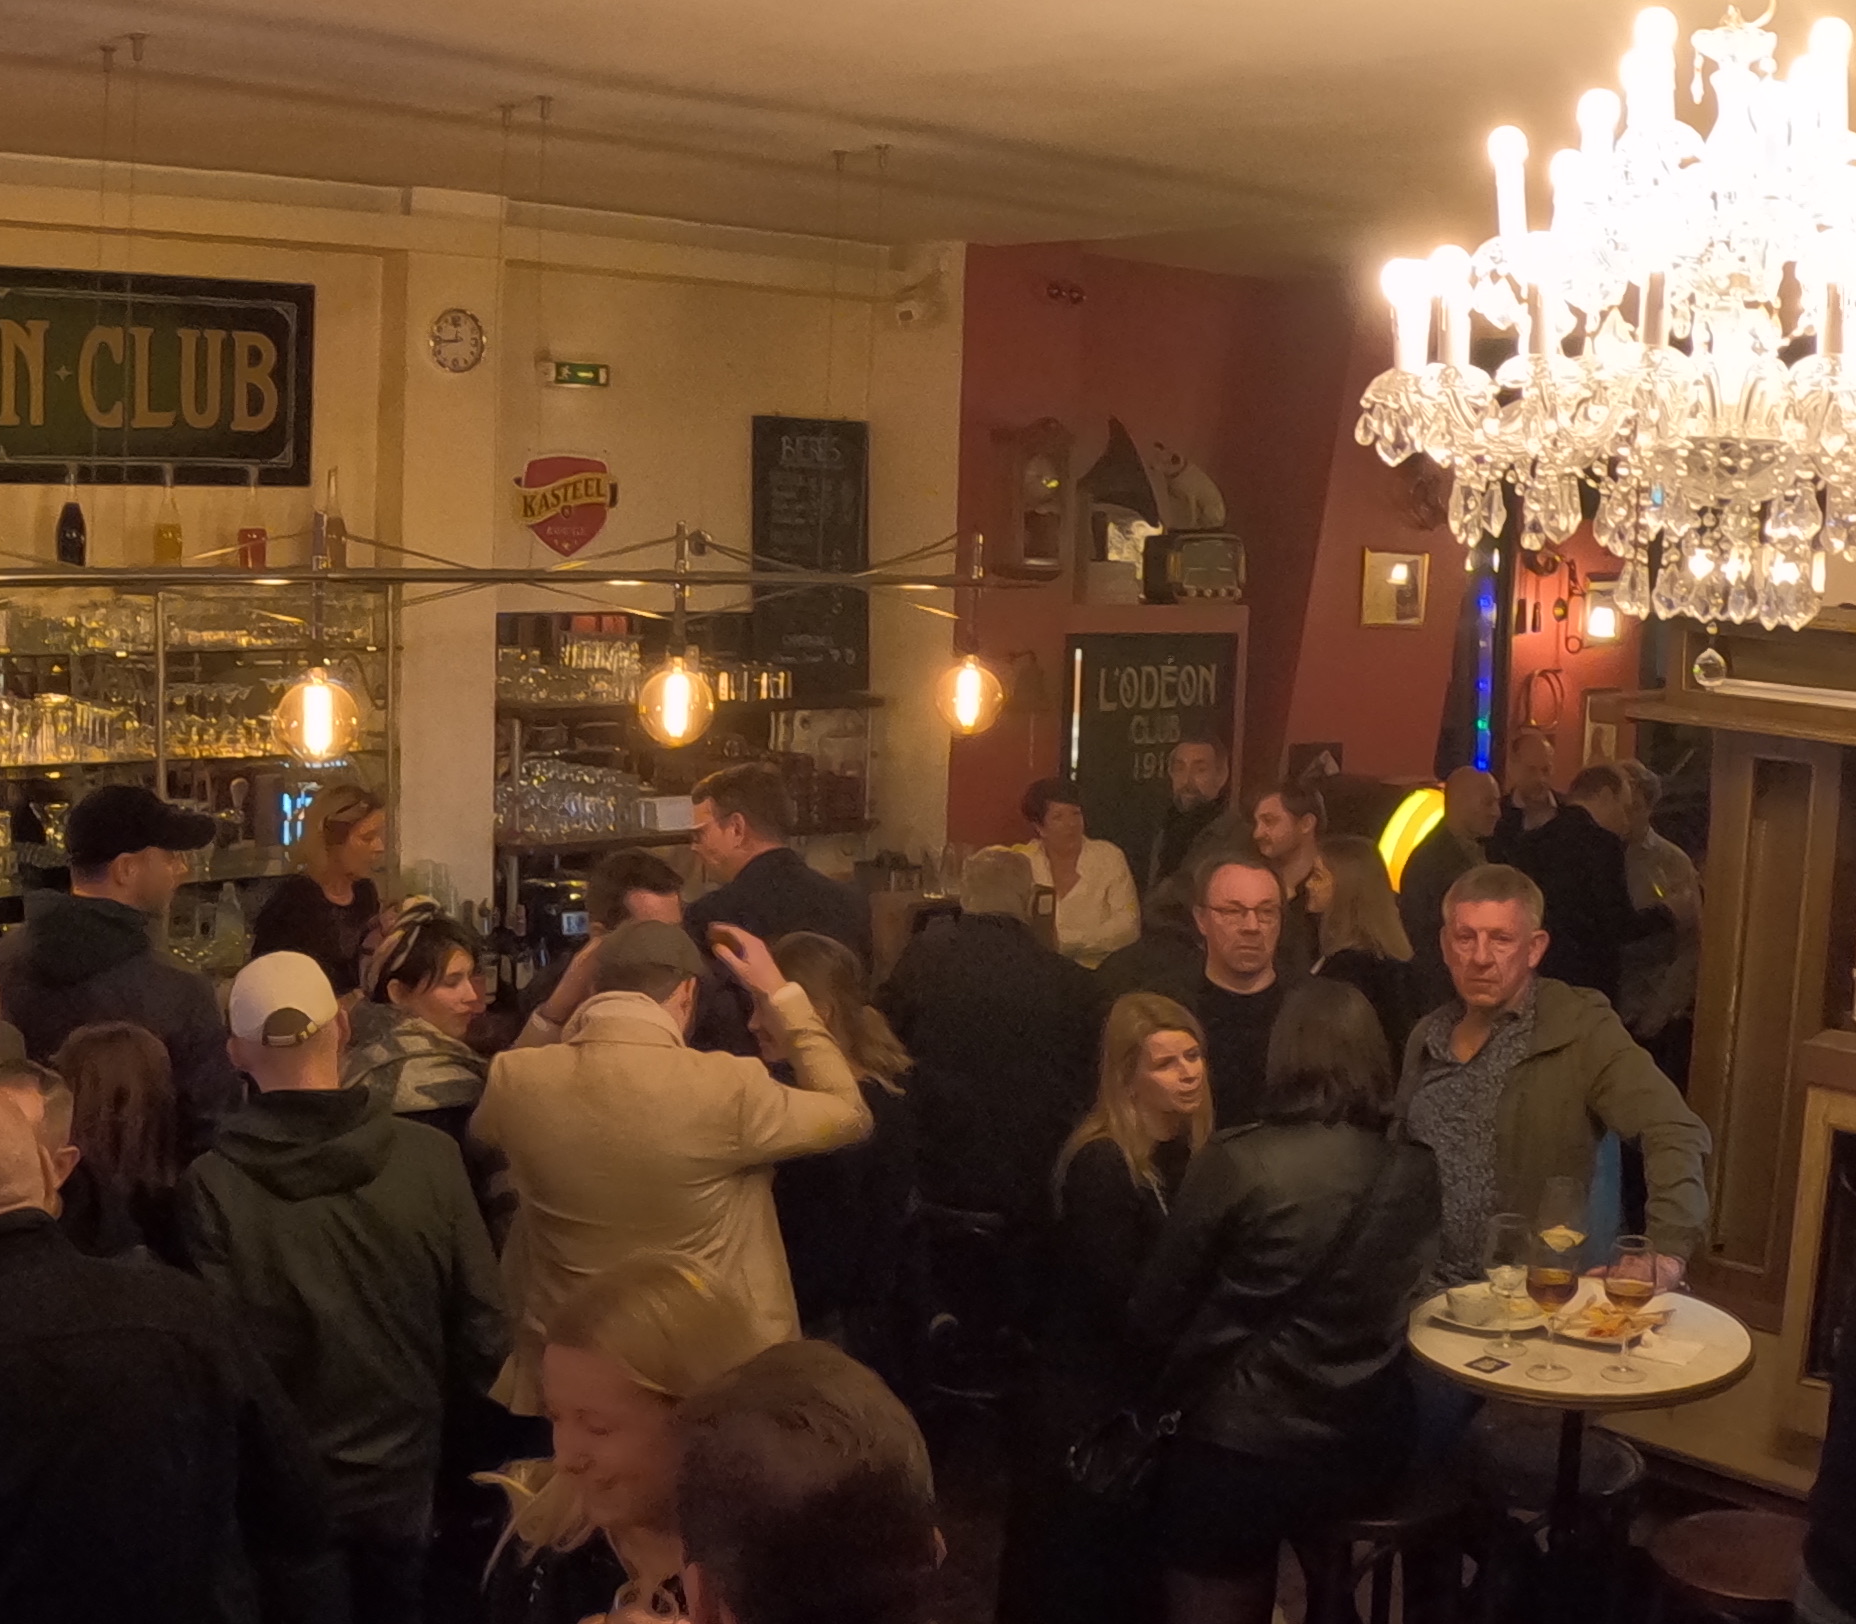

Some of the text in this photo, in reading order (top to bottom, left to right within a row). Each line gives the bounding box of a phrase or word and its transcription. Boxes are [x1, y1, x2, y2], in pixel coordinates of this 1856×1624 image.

[78, 324, 278, 432] CLUB
[522, 477, 607, 518] KASTEEL
[1130, 715, 1181, 744] CLUB
